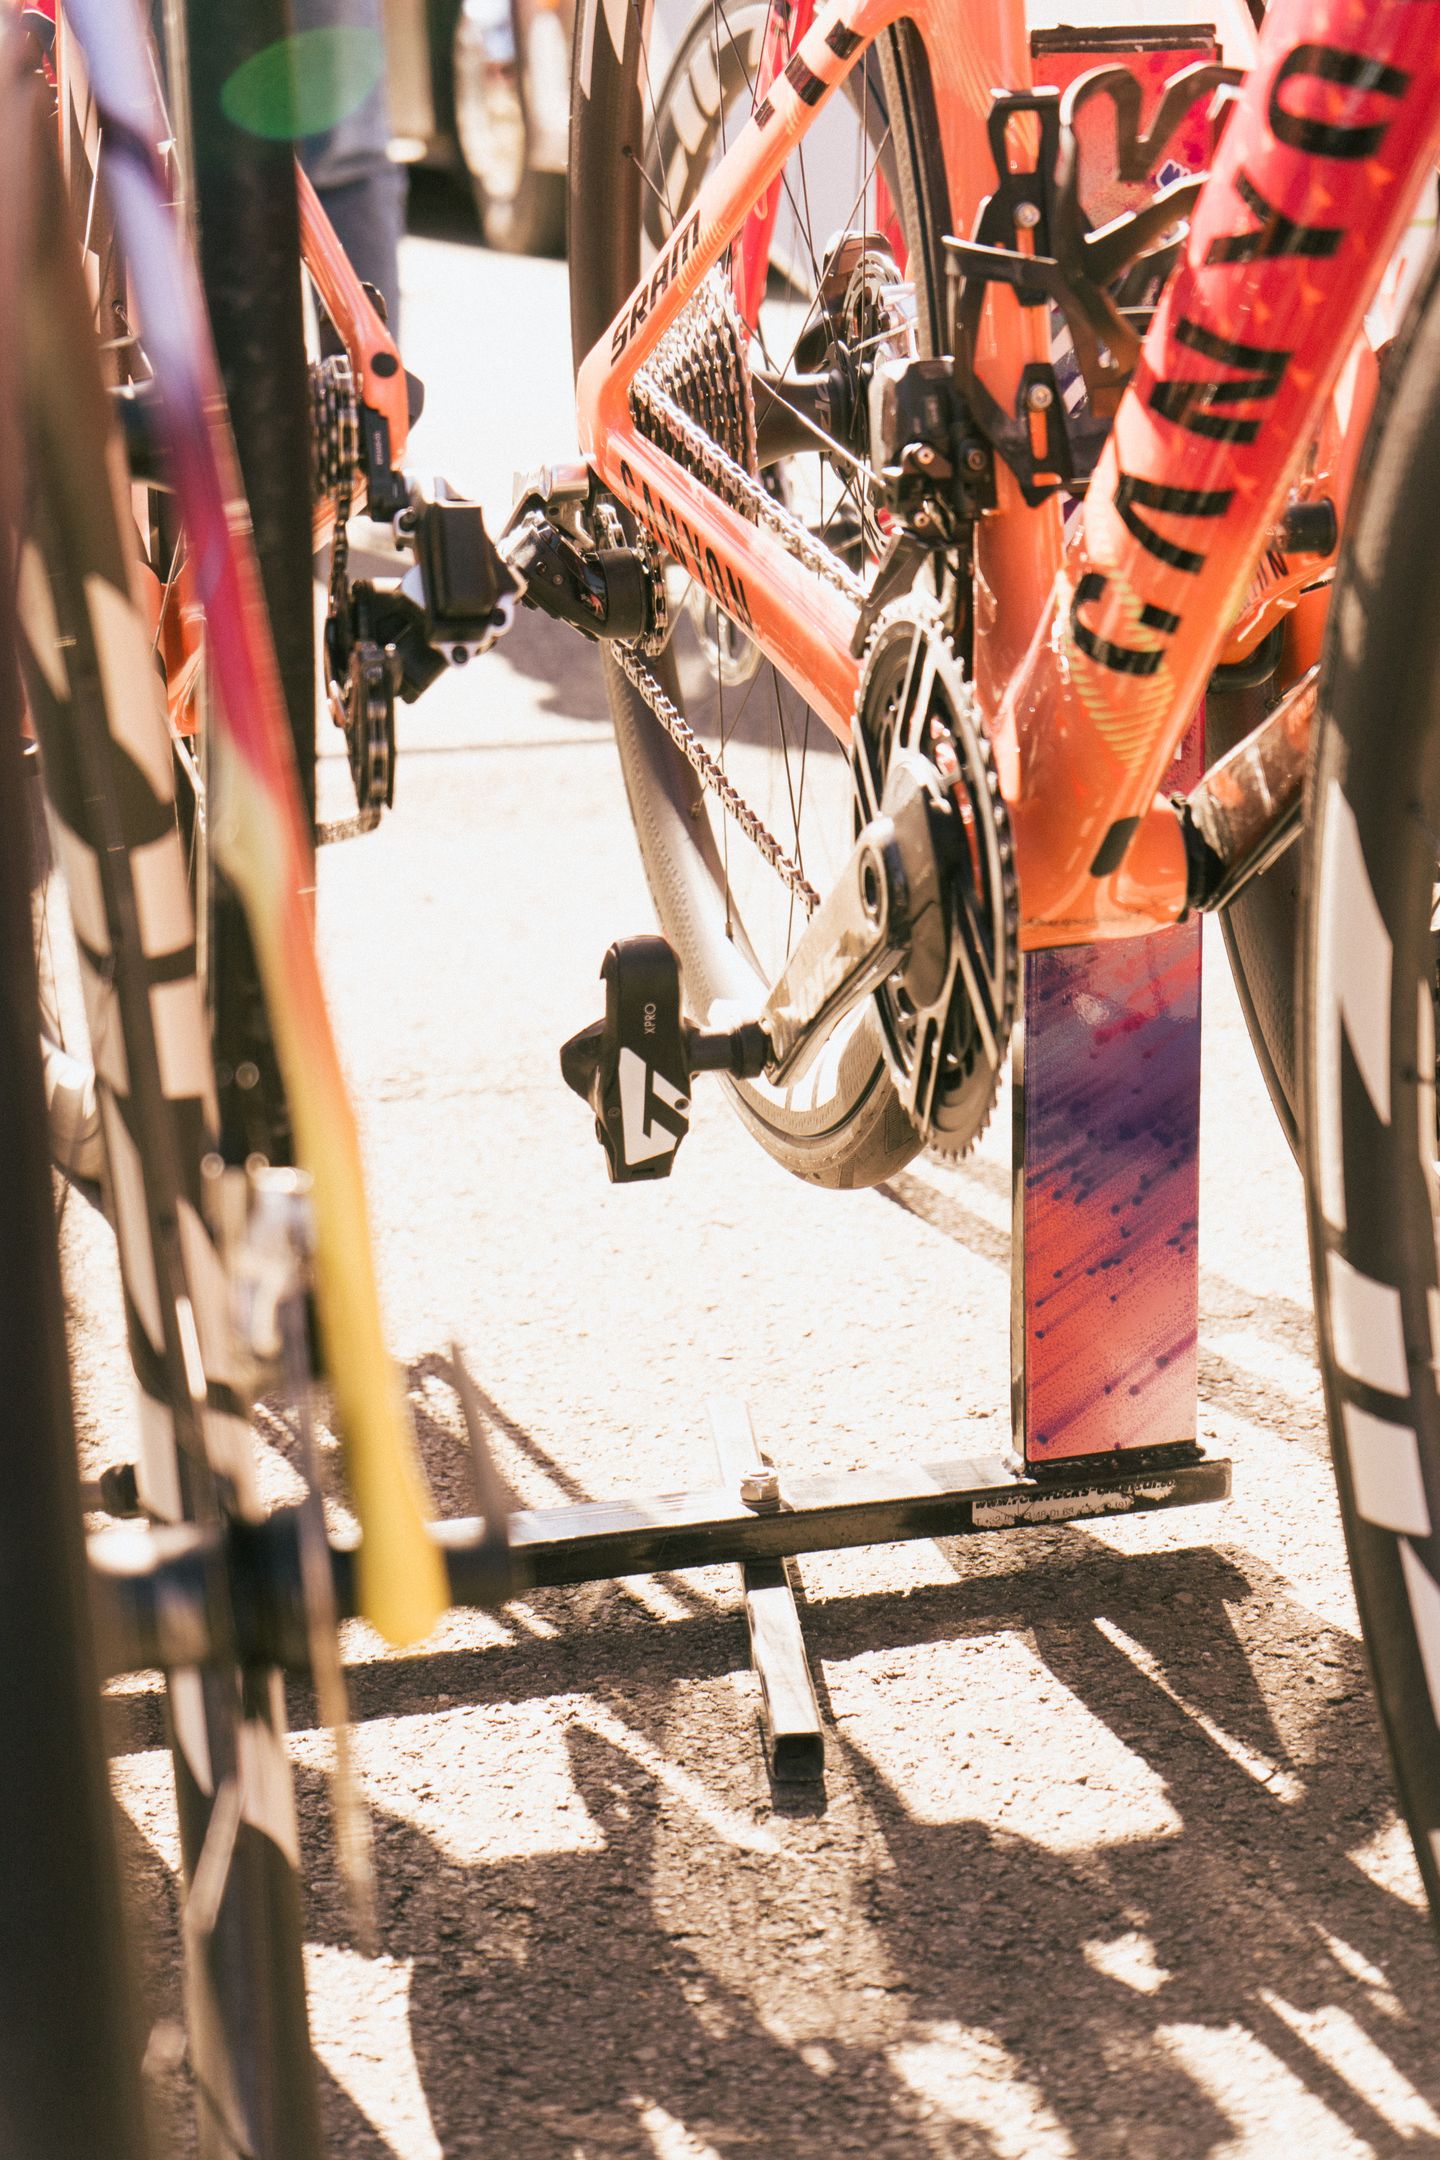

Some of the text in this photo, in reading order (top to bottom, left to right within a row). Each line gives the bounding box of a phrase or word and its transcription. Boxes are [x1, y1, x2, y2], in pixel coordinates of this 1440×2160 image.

[610, 208, 701, 368] SRAM
[620, 458, 756, 632] CANYON
[643, 1003, 657, 1035] XPRO
